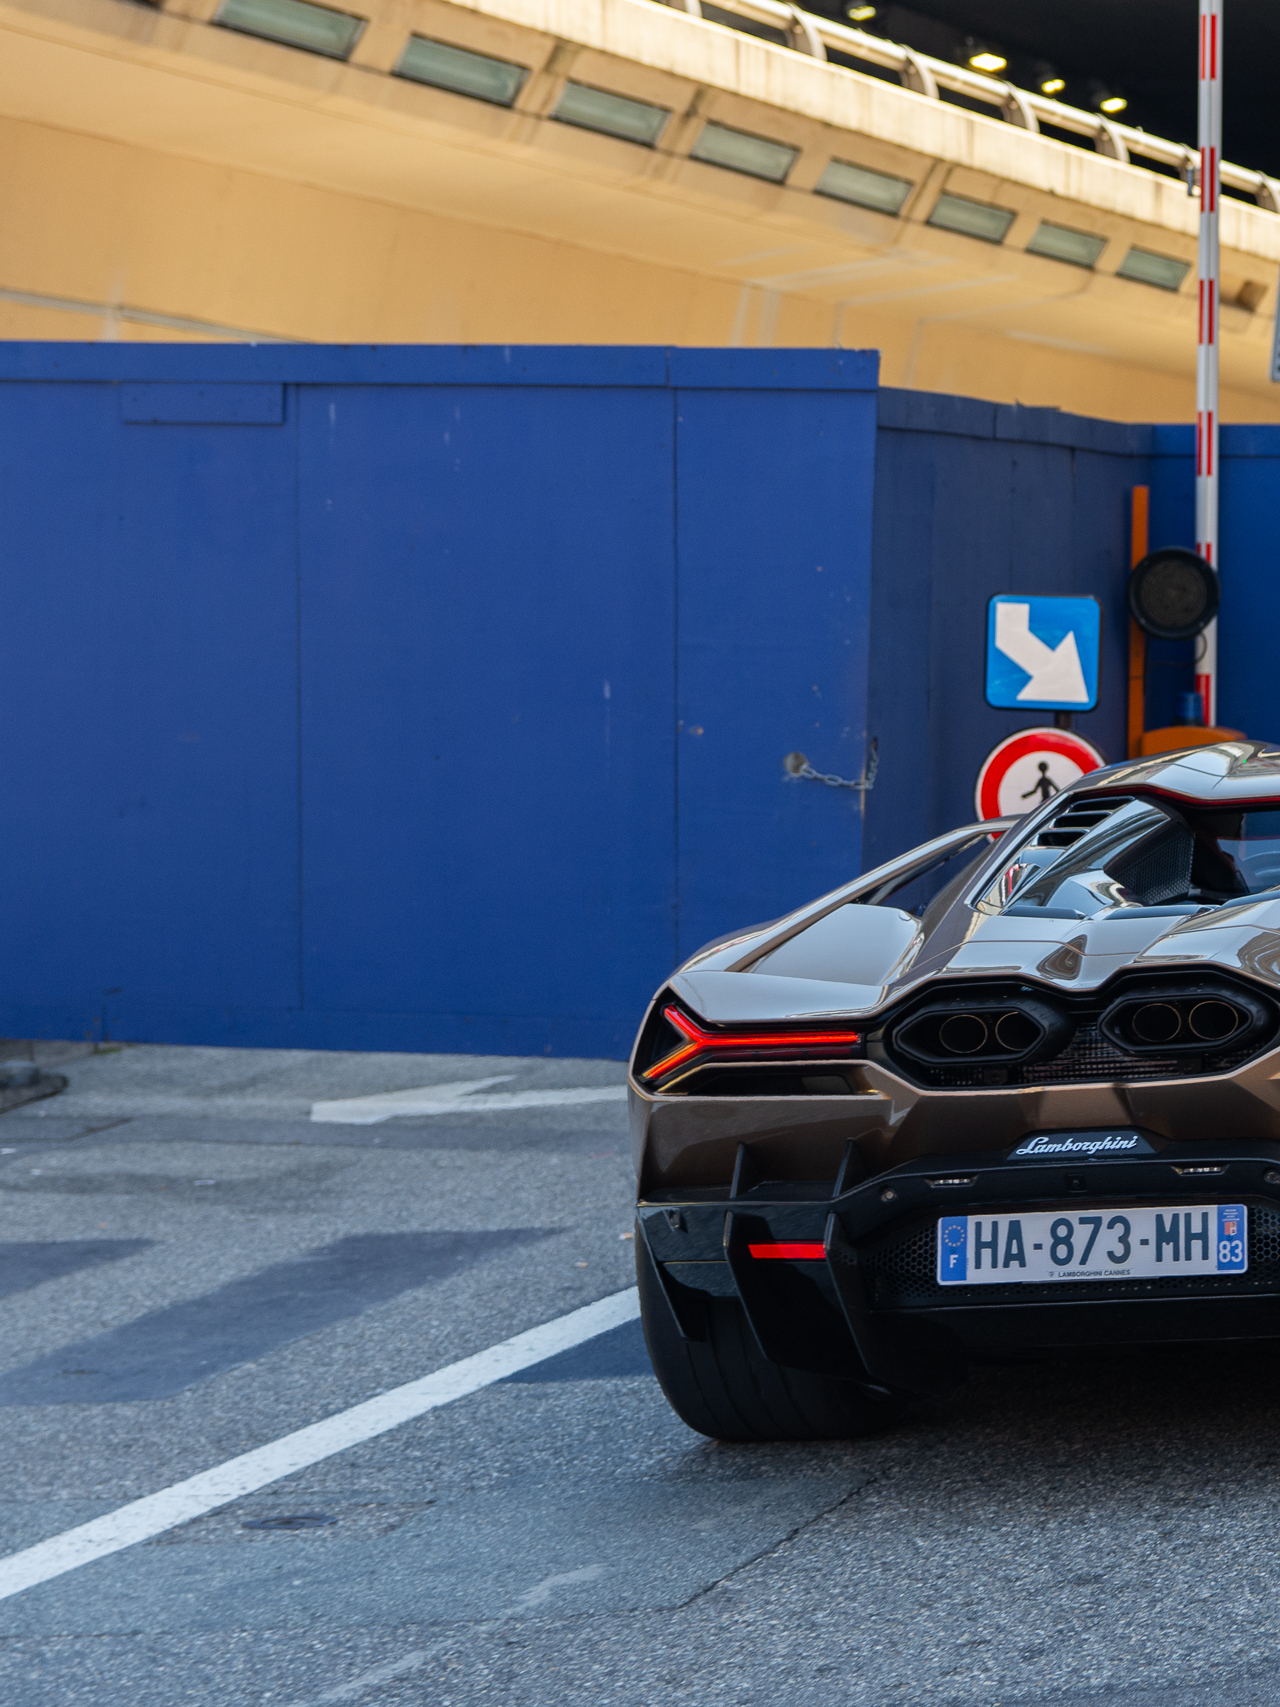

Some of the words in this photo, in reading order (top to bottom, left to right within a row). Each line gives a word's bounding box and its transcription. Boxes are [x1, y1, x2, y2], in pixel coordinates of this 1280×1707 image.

[1016, 1136, 1138, 1155] Lamborghini
[975, 1212, 1209, 1269] HA-873-MH
[950, 1254, 958, 1268] F
[1219, 1240, 1243, 1263] 83
[1058, 1270, 1102, 1278] LAMBORGHINI
